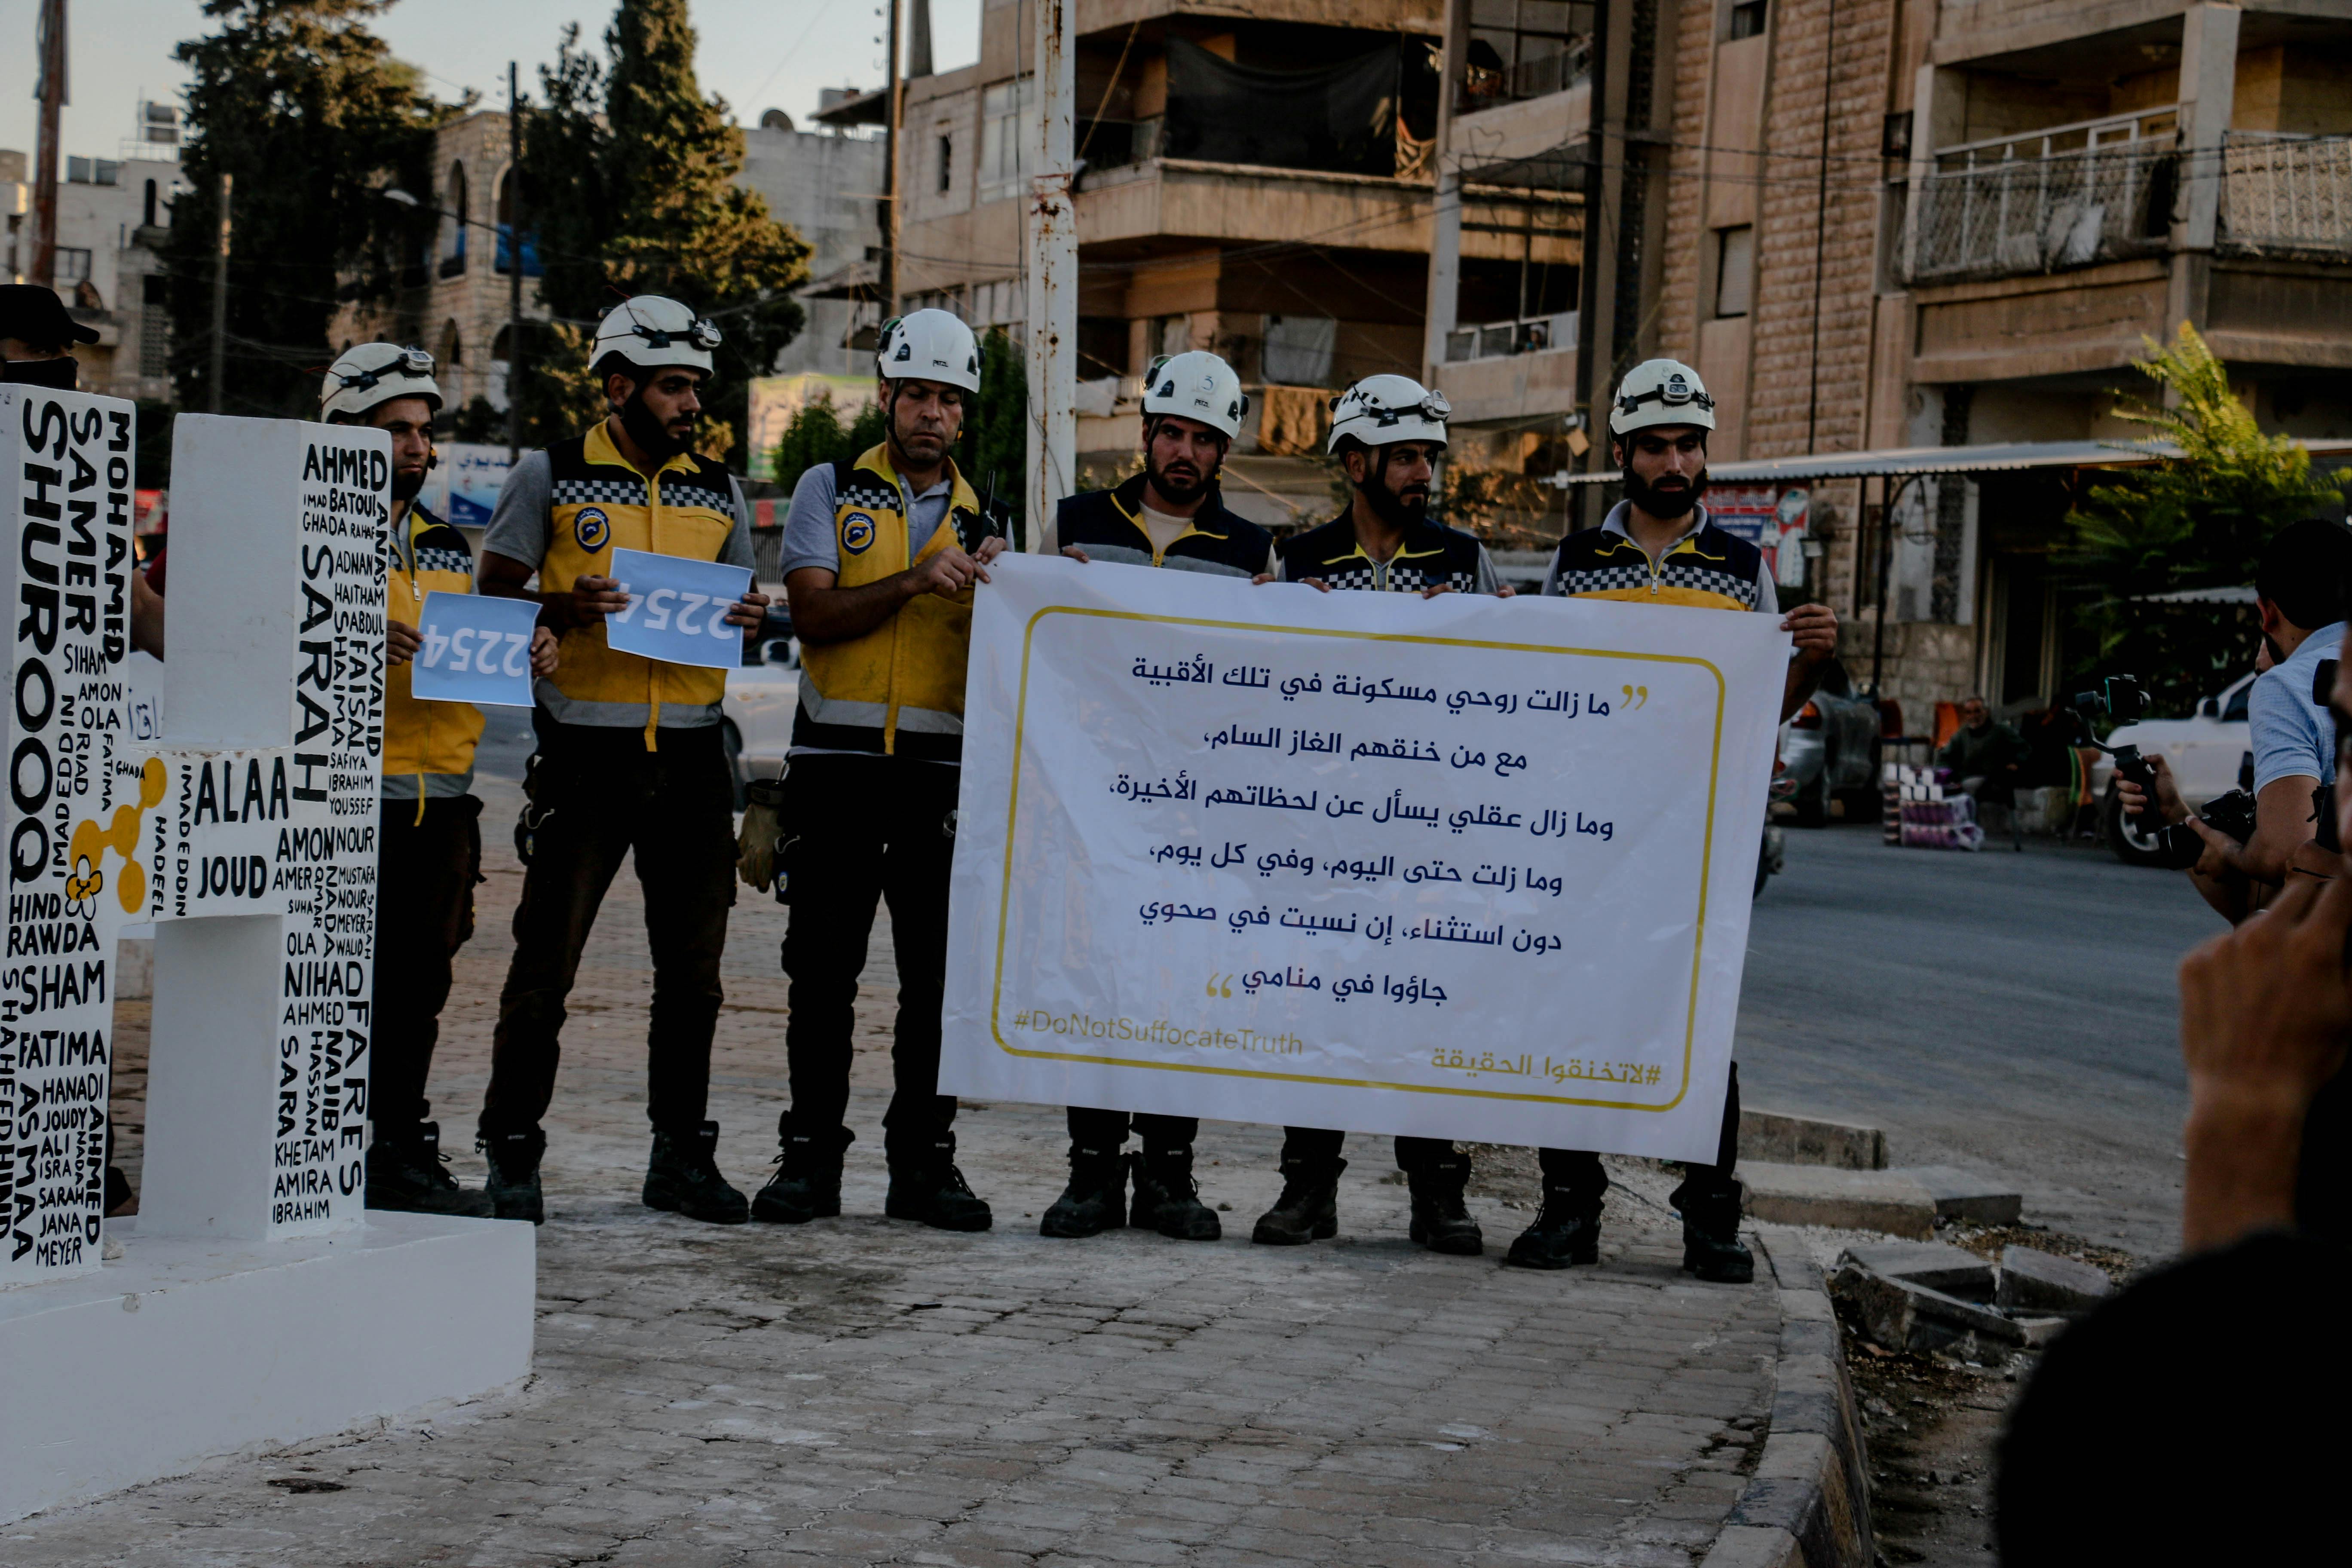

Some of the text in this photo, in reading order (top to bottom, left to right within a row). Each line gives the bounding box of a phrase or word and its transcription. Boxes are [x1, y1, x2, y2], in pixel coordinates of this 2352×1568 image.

[303, 443, 387, 492] AHMED
[64, 407, 102, 635] SAMER
[304, 488, 376, 517] IMAD BATOUL
[103, 411, 130, 664] MOHAMED
[303, 512, 375, 540] GHADA RAHAF
[374, 502, 388, 585] ANAS
[336, 550, 373, 576] ADNAN
[335, 582, 384, 607] HAITHAM
[615, 582, 740, 640] 2254
[350, 610, 384, 636] ABDUL
[9, 398, 68, 893] SHUROOQ
[64, 643, 107, 674] SIHAM
[422, 625, 528, 677] 2254
[79, 683, 121, 701] AMON
[292, 545, 334, 802] SARAH
[332, 611, 349, 747] SHAIMA
[1132, 653, 1610, 718] ما زالت روحي مسكونة في تلك الأقبية
[347, 640, 368, 751] FAISAL
[366, 640, 384, 757] WALID
[82, 707, 120, 730] OLA
[74, 733, 90, 796] RIAD
[116, 760, 145, 781] GHADA
[330, 752, 368, 770] SAFIYA
[1204, 724, 1527, 777] مع من خنقهم الغاز السام،
[52, 695, 75, 878] IMADEDDIN
[101, 733, 113, 812] FATIMA
[194, 756, 288, 826] ALAA
[329, 774, 373, 792] IBRAHIM
[329, 797, 373, 815] YOUSSEF
[1109, 770, 1613, 841] وما زال عقلي يسأل عن لحظاتهم الأخيرة،
[175, 765, 192, 916] IMADEDDIN
[276, 826, 374, 863] AMON NOUR
[152, 816, 167, 917] HADEEL
[197, 855, 267, 898] JOUD
[273, 867, 312, 890] AMER
[338, 866, 375, 885] MUSTAFA
[1149, 842, 1562, 897] وما زلت حتى اليوم، وفي كل يوم،
[9, 893, 61, 924] HIND
[288, 899, 313, 914] SUHA
[324, 866, 338, 958] NADA
[338, 889, 367, 909] NOUR
[7, 922, 100, 958] RAWDA
[287, 932, 316, 956] OLA
[337, 914, 365, 934] MEYER
[364, 894, 374, 959] SARAH
[1139, 902, 1561, 955] دون استثناء، إن نسيت في صحوي
[20, 960, 105, 1014] SHAM
[285, 961, 363, 998] NIHAD
[1242, 966, 1447, 1006] جاؤوا في منامي
[283, 1001, 344, 1026] AHMED
[1014, 1010, 1303, 1055] #DoNotSuffocateTruth
[19, 1029, 107, 1069] FATIMA
[43, 1073, 103, 1105] HANADI
[277, 1035, 299, 1139] SARA
[305, 1031, 323, 1137] HASSAN
[322, 1030, 343, 1132] NAJIB
[339, 1001, 370, 1196] FARES
[42, 1107, 87, 1133] JOUDY
[41, 1133, 69, 1158] ALI
[75, 1131, 86, 1186] NADA
[275, 1139, 334, 1168] KHETAM
[12, 1083, 40, 1262] ASMAA
[40, 1159, 71, 1179] ISRA
[85, 1105, 104, 1246] AHMED
[274, 1169, 333, 1198] AMIRA
[39, 1187, 84, 1209] SARAH
[273, 1199, 330, 1224] IBRAHIM
[39, 1212, 82, 1237] JANA
[37, 1237, 82, 1267] MEYER
